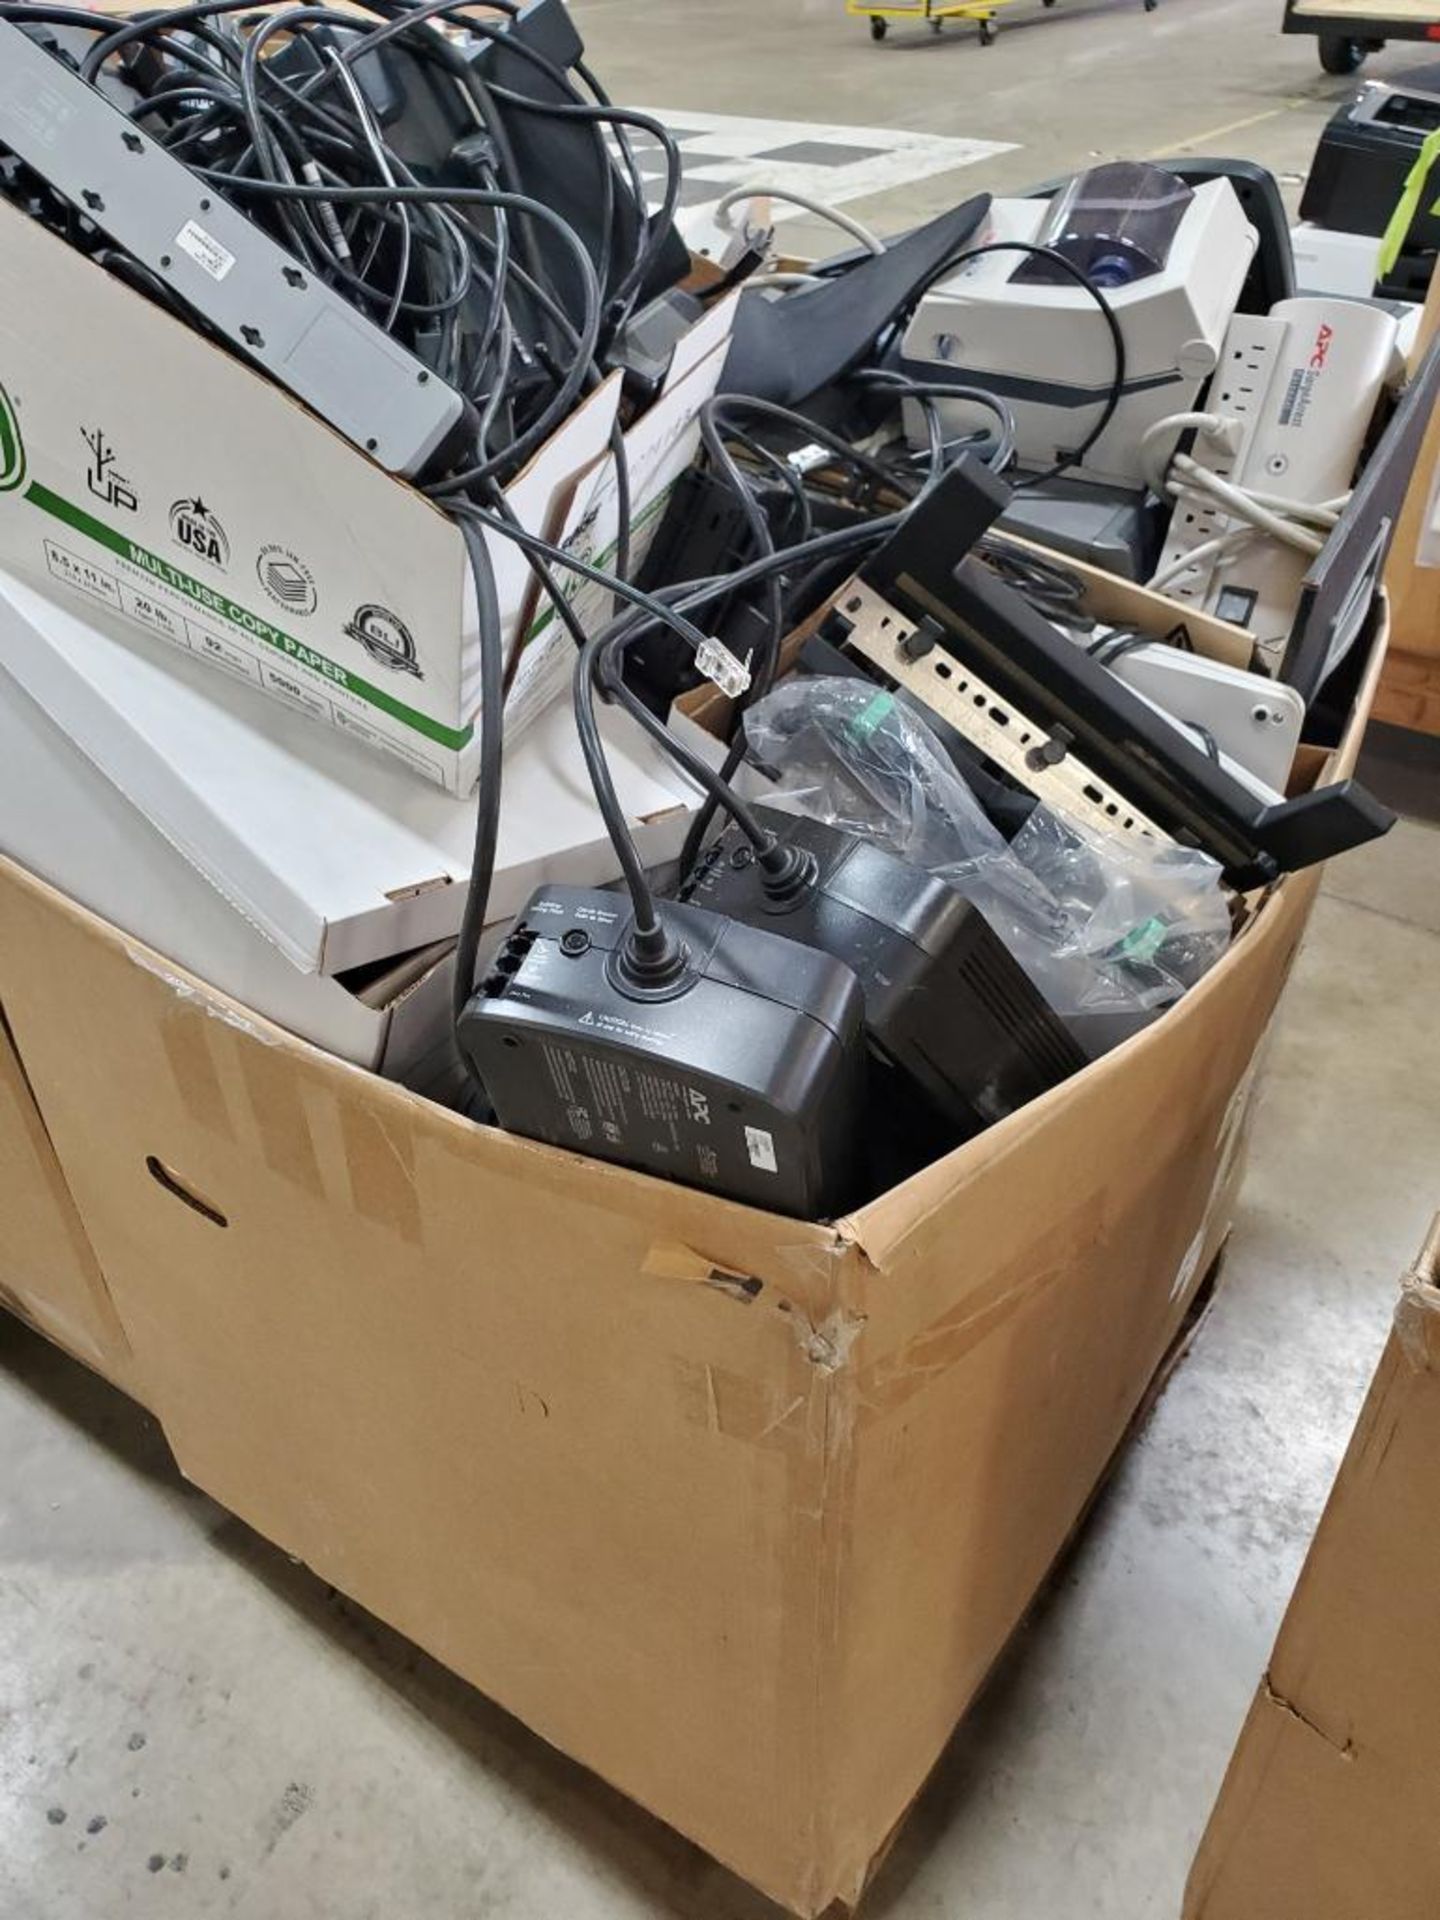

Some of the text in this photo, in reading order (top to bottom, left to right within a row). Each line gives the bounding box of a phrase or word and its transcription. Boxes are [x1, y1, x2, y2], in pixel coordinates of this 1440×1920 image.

[1310, 323, 1333, 369] APC
[177, 517, 222, 565] USA
[129, 542, 226, 614] MULTI-USE
[228, 603, 280, 648] COPY
[283, 638, 350, 686] PAPER
[689, 1087, 711, 1126] APC
